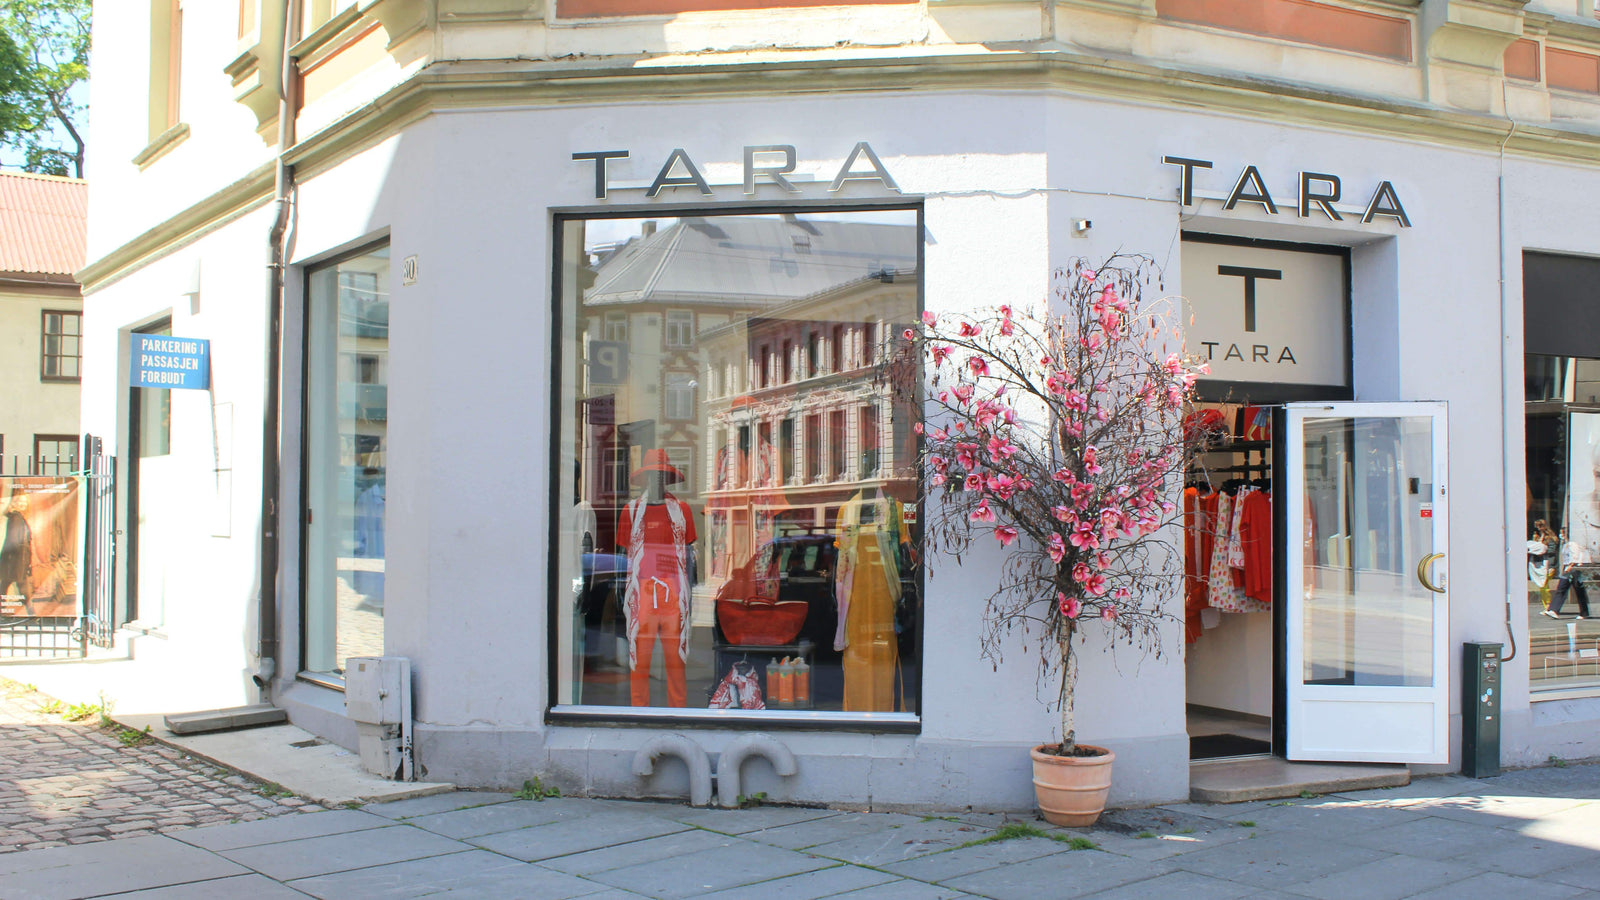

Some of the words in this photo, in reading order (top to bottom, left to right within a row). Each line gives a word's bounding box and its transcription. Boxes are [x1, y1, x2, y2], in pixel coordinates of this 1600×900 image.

[572, 141, 903, 200] TARA
[1161, 155, 1413, 228] TARA
[1218, 264, 1282, 333] T
[142, 339, 197, 354] PARKERING
[200, 343, 204, 355] I
[1201, 341, 1297, 365] TARA
[141, 354, 198, 370] PASSASJEN
[141, 370, 186, 385] FORBUDT
